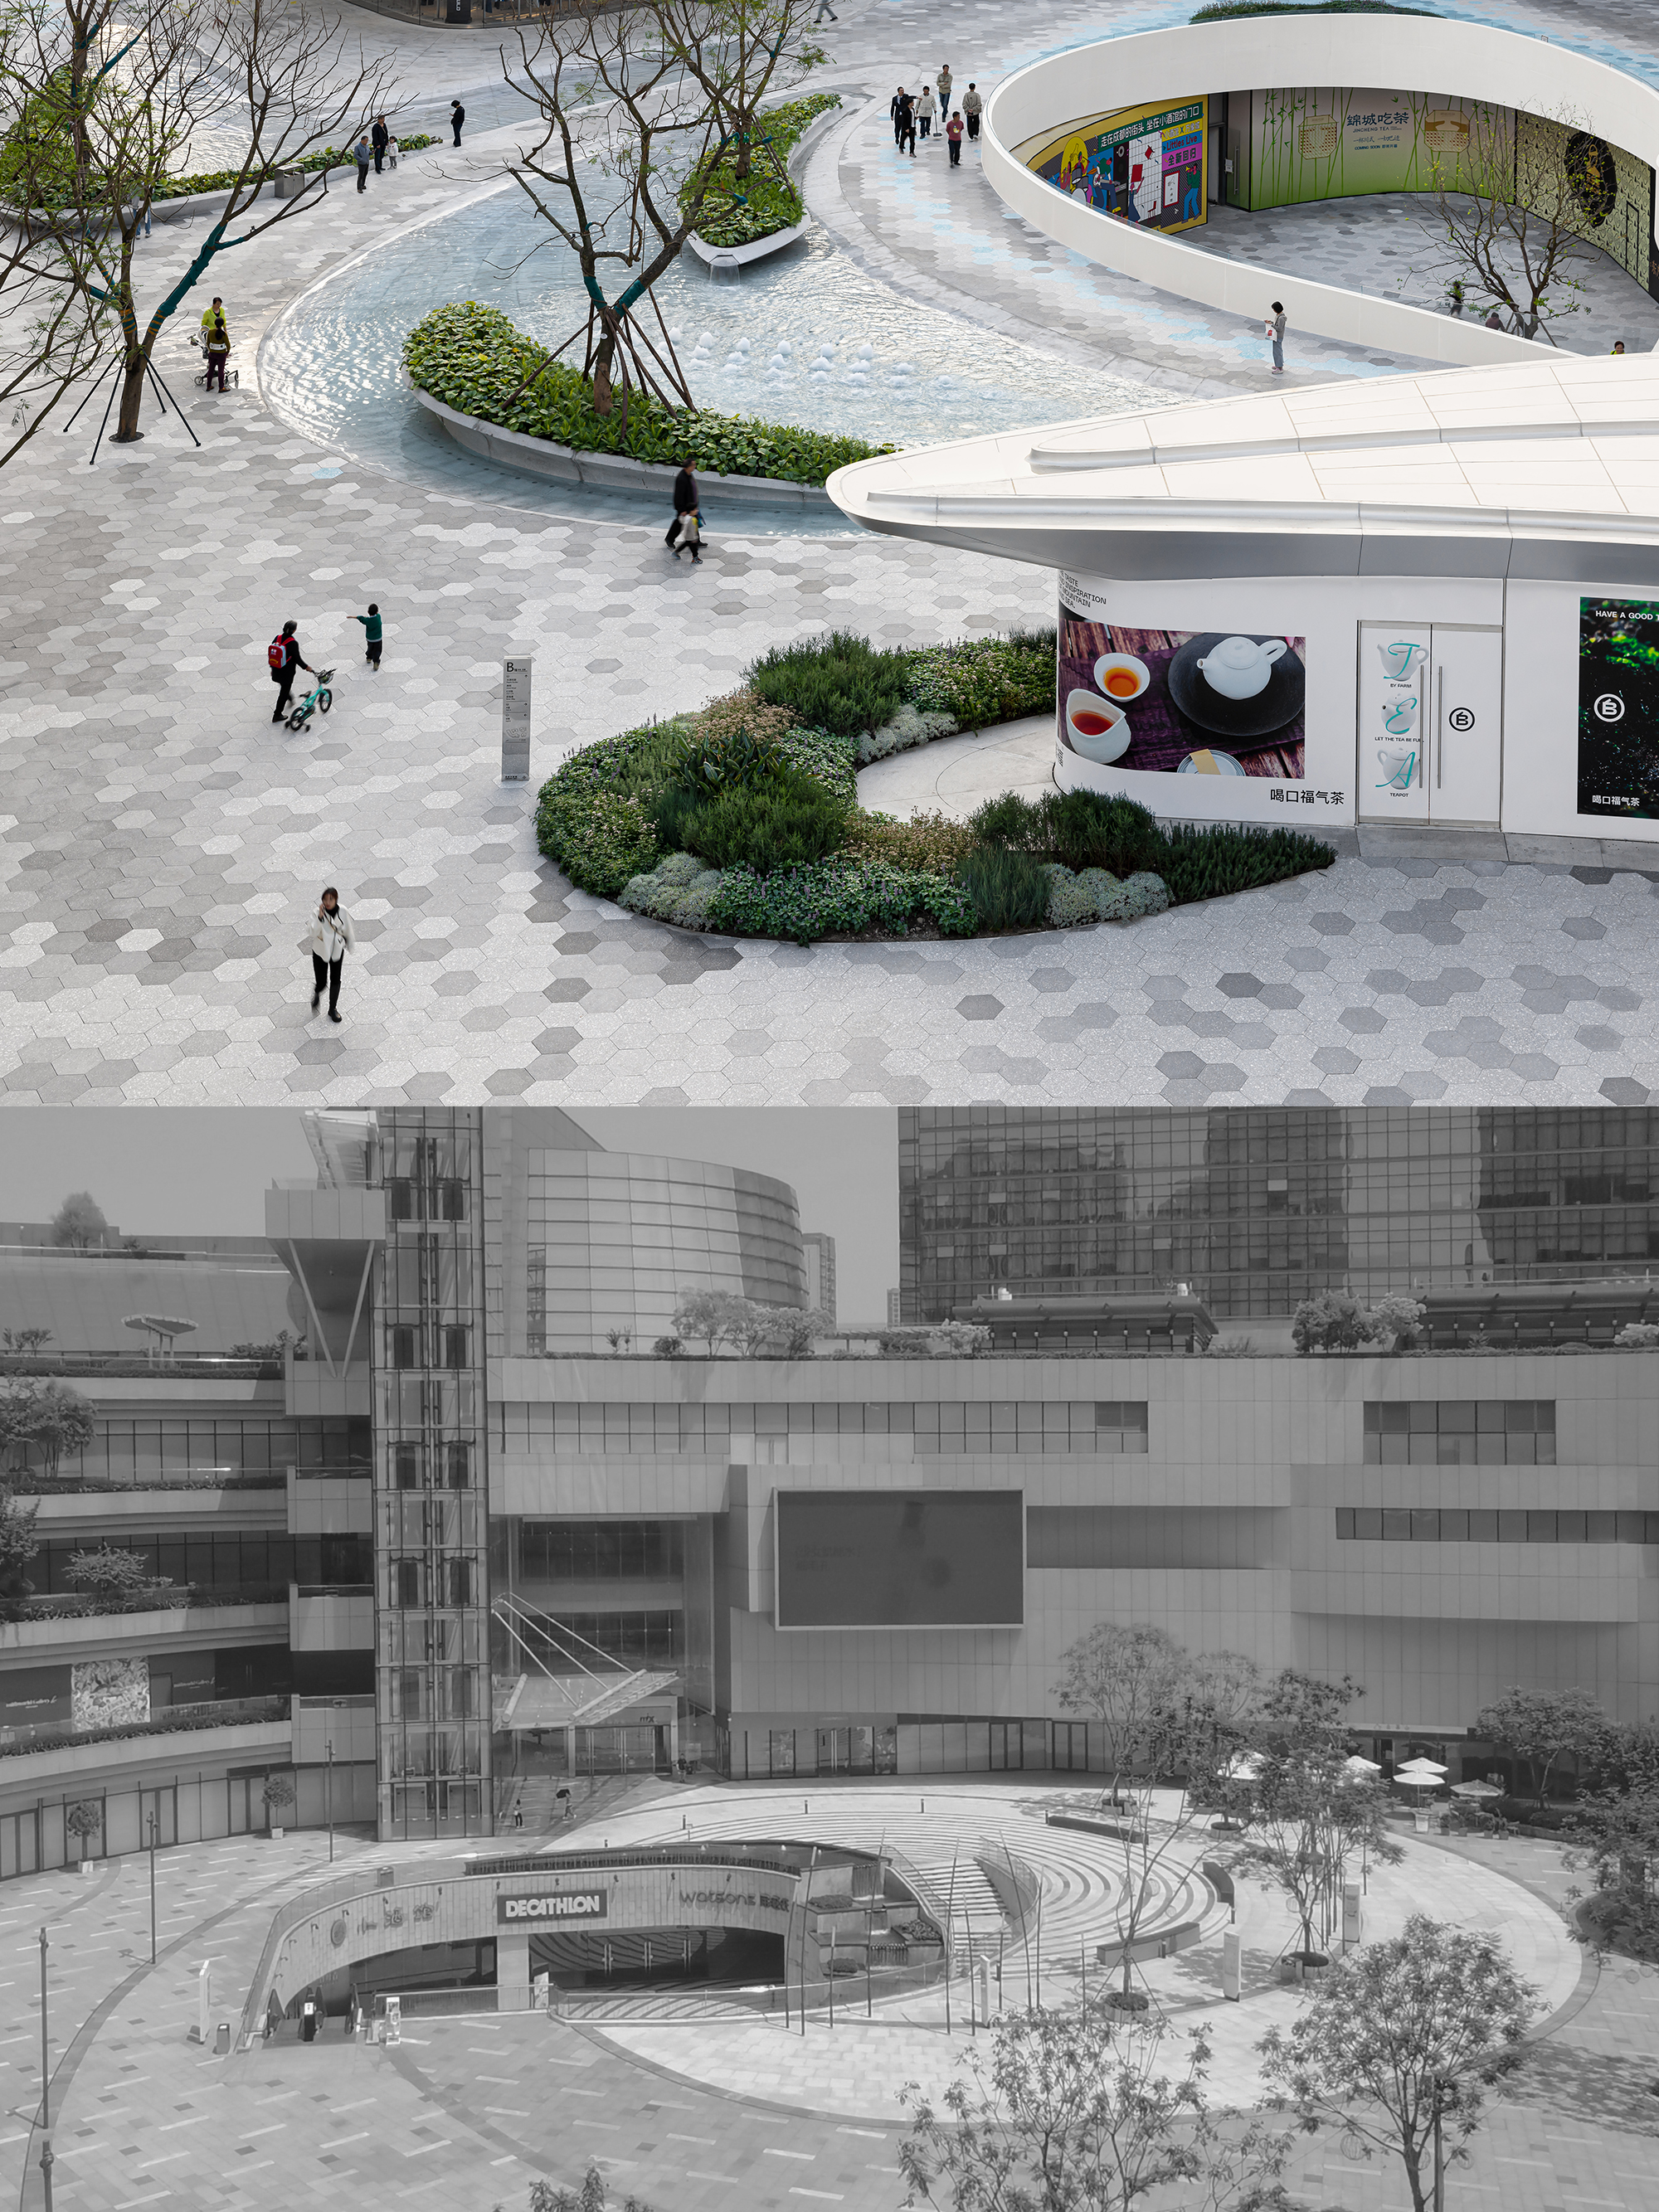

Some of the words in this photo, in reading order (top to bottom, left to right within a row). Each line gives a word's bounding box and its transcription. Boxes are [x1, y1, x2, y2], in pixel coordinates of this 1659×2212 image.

[1101, 122, 1145, 148] 走在成都的街头
[1146, 105, 1199, 131] 坐在小酒馆的门口
[1346, 112, 1409, 126] 錦城吃茶
[1185, 135, 1198, 145] Live
[1063, 586, 1091, 608] MOUNTAIN
[1066, 581, 1107, 605] INSPIRATION
[1628, 612, 1653, 620] GOOD
[1270, 789, 1345, 805] 喝口福气茶
[1592, 795, 1640, 806] 喝口福气茶
[506, 1895, 600, 1918] DECATHLON
